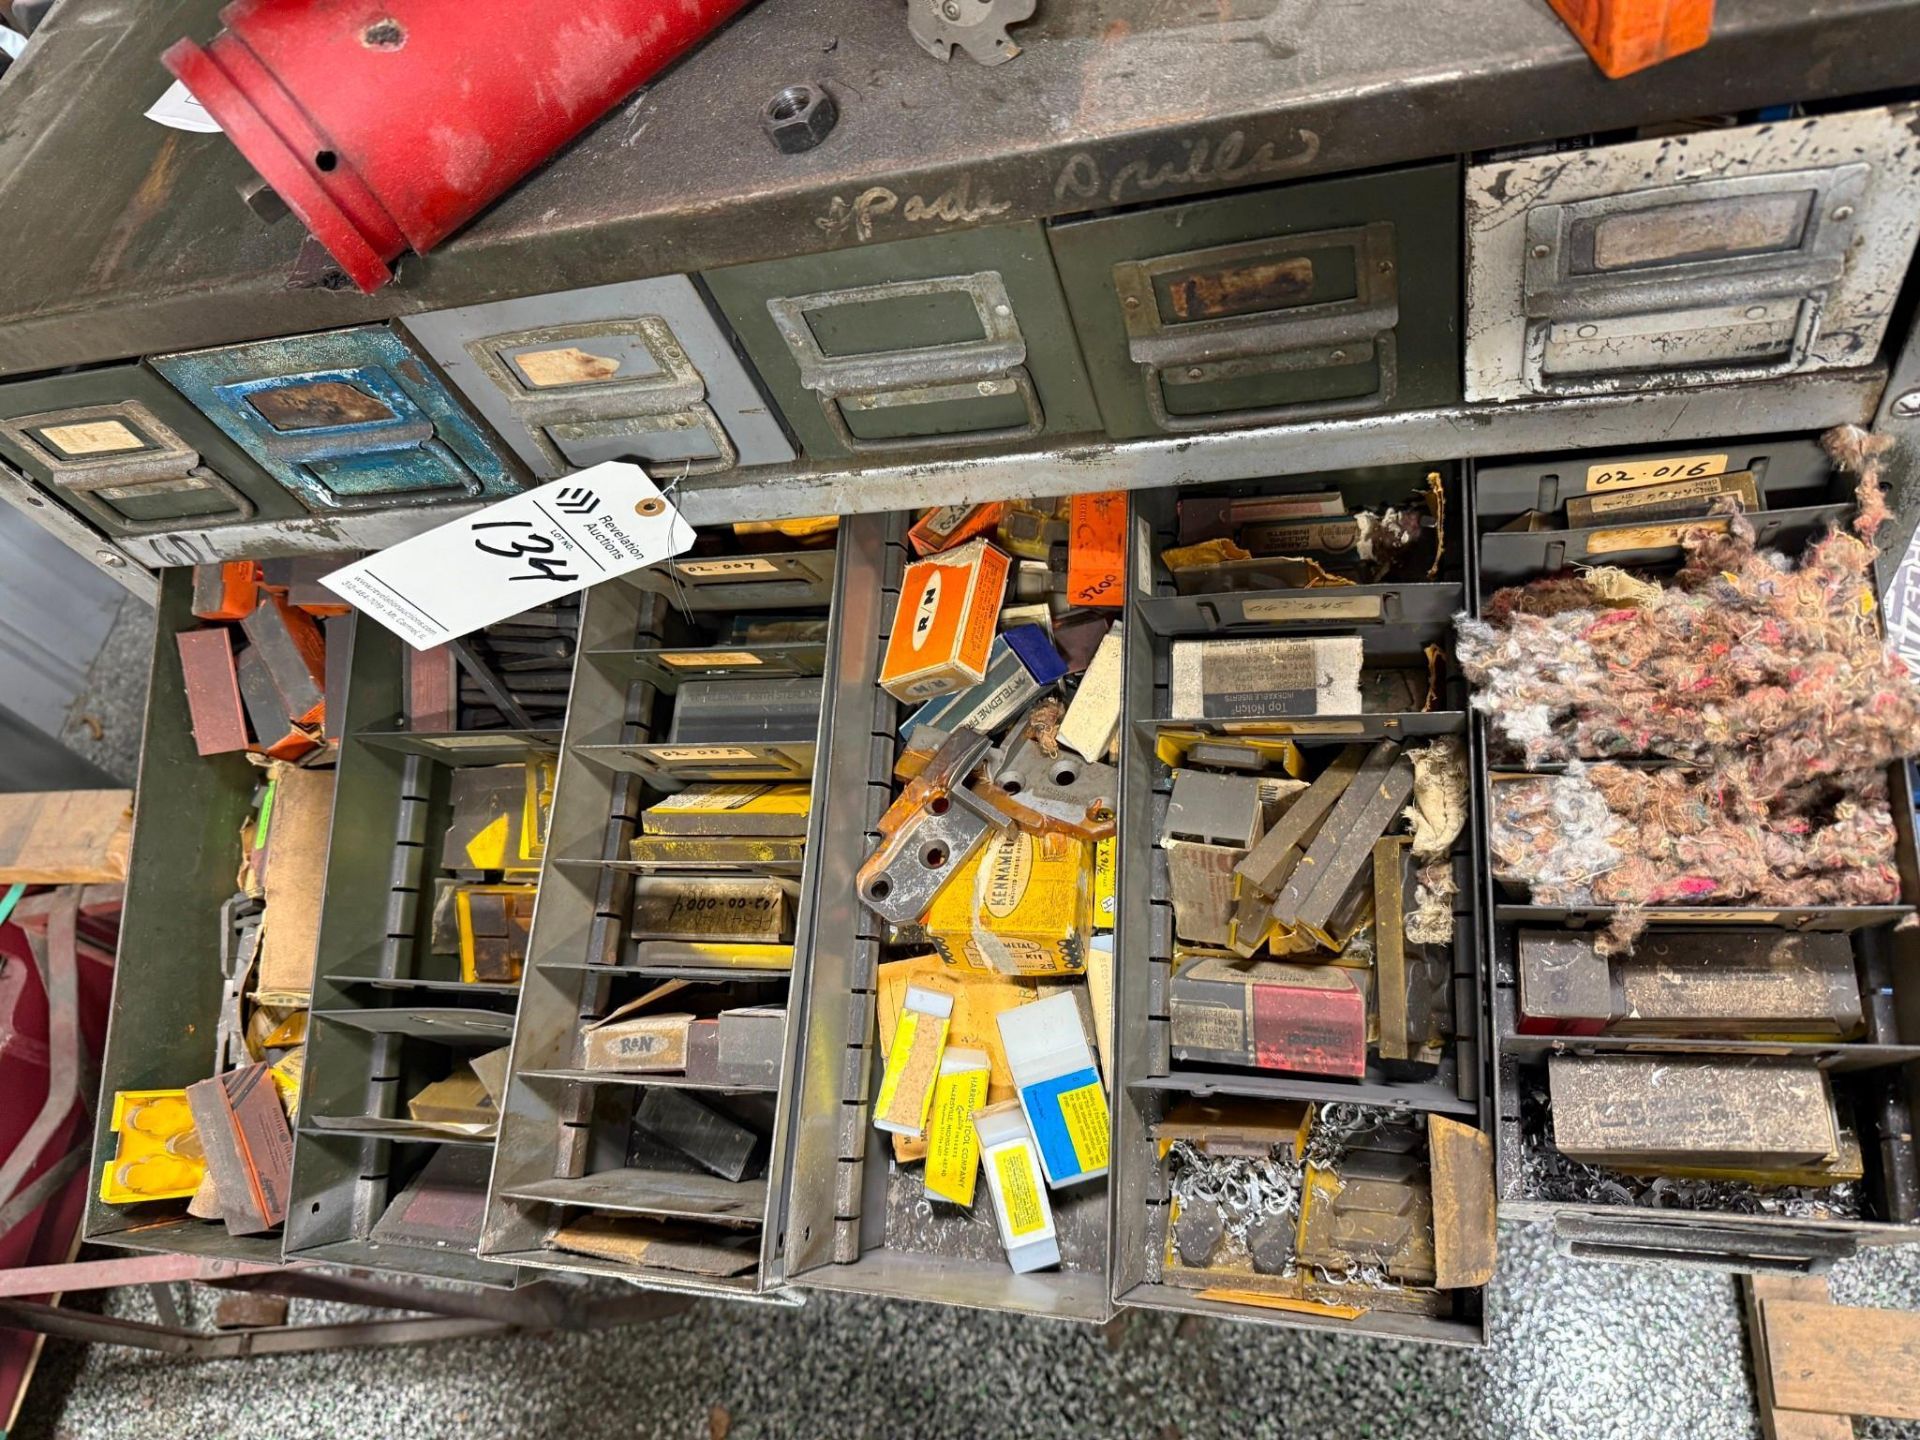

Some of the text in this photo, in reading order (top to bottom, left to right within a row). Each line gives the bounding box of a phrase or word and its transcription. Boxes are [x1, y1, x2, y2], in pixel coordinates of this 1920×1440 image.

[472, 521, 579, 582] 134
[550, 529, 565, 544] LOT
[583, 522, 624, 561] Auctions
[598, 514, 646, 561] Revelation
[978, 685, 1019, 723] TELEDYNE
[1235, 702, 1288, 715] Top Notch
[991, 837, 1015, 906] KENNAMET
[620, 1036, 655, 1056] R&N
[958, 1076, 978, 1188] HARRISVILLE TOOL COMPANY
